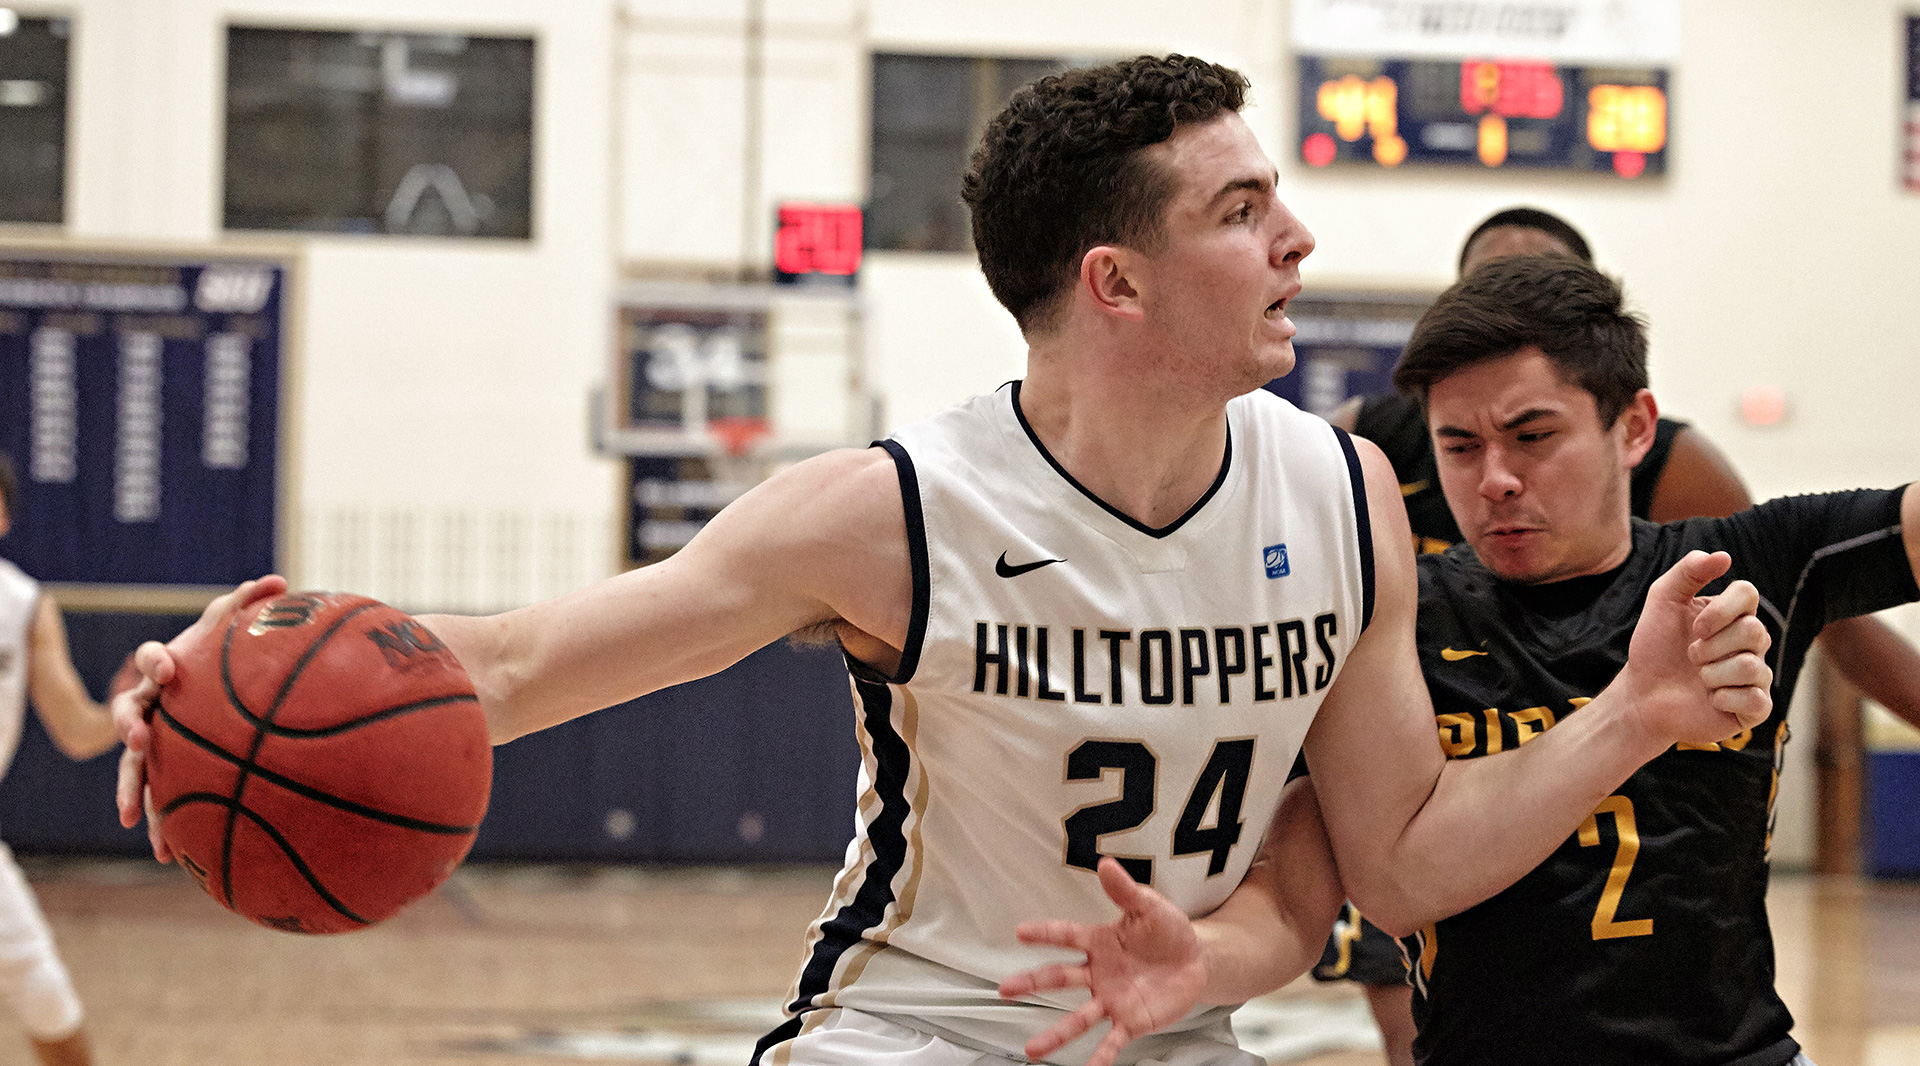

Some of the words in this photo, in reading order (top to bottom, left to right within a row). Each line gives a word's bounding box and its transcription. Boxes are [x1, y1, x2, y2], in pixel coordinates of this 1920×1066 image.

[973, 613, 1339, 706] HILLTOPPERS
[1061, 735, 1258, 886] 24
[1577, 795, 1654, 941] 2
